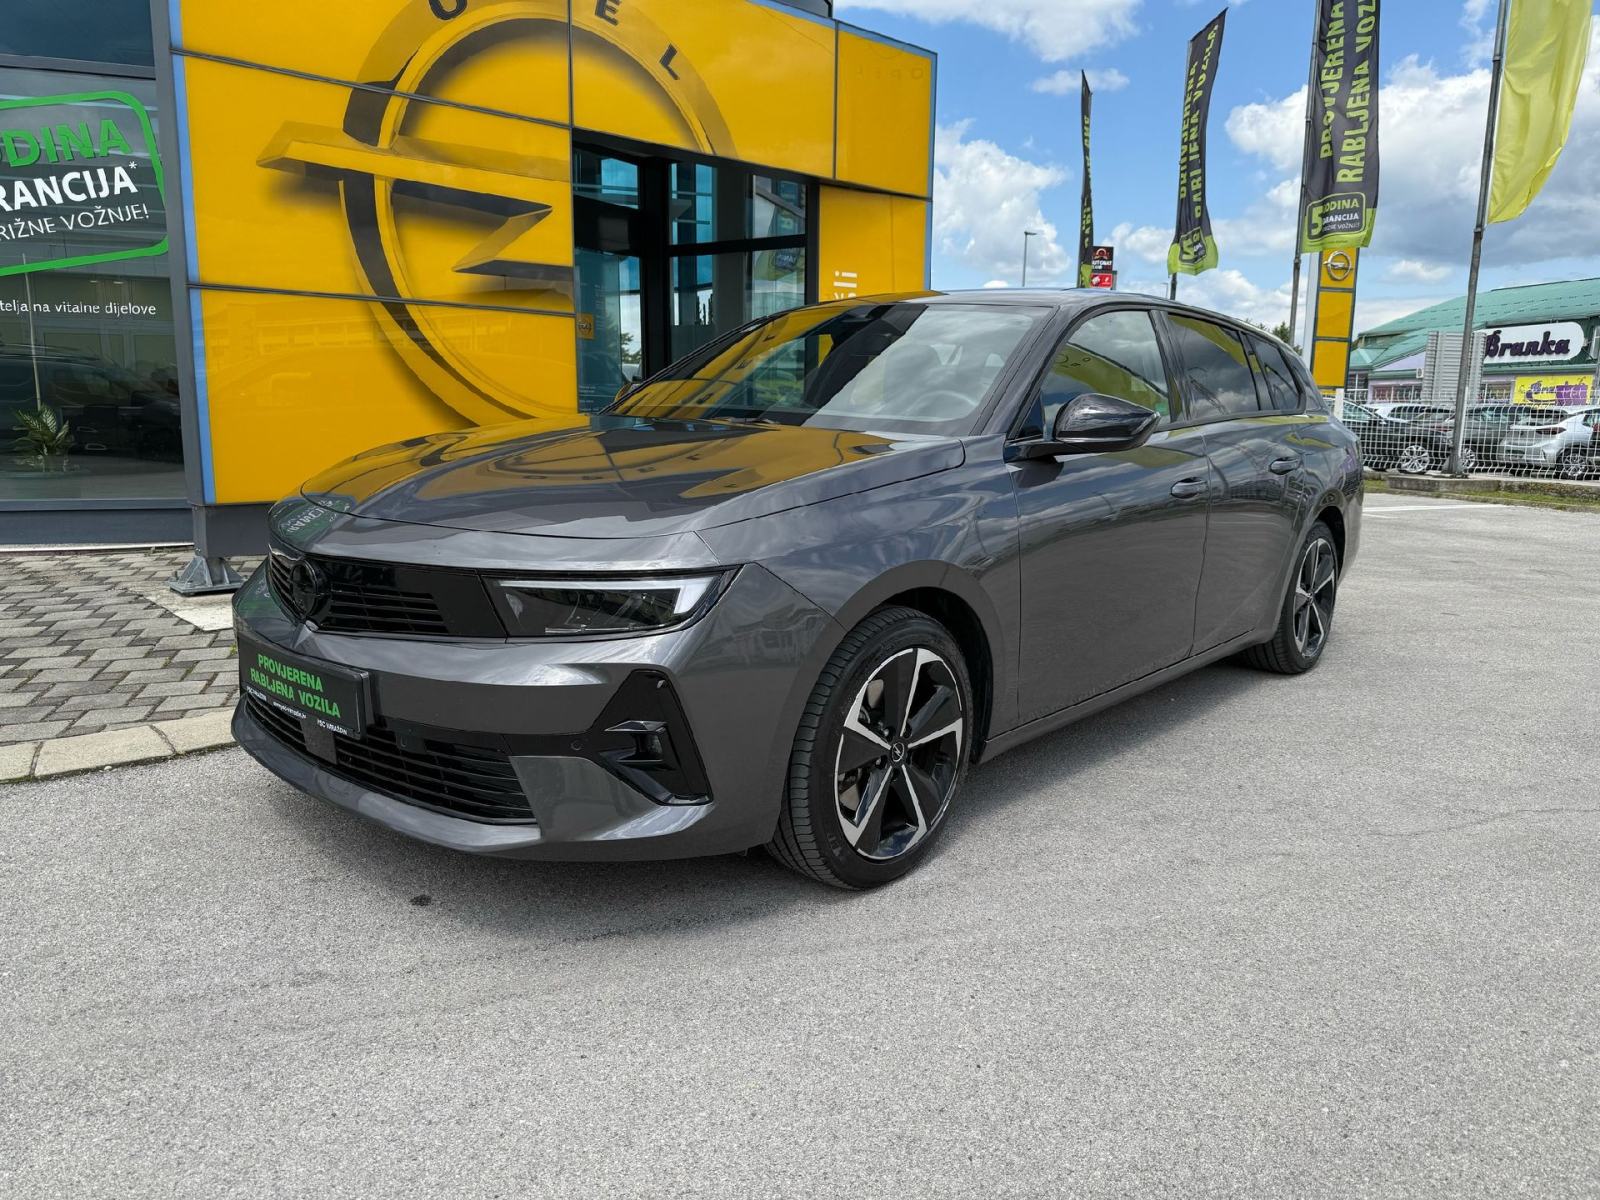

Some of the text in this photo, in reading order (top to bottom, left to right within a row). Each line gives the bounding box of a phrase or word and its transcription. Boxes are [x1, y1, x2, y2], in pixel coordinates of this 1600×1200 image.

[1319, 1, 1346, 160] PROVJERENA
[1336, 0, 1377, 184] RABLJENA VOZ
[60, 203, 149, 231] VOŽNJE!
[33, 303, 51, 313] na
[55, 300, 100, 314] vitalne
[105, 302, 156, 317] dijelove
[1485, 329, 1571, 358] Branka
[250, 667, 295, 702] RABLJENA
[298, 689, 341, 719] VOZILA
[257, 653, 324, 693] PROVJERENA
